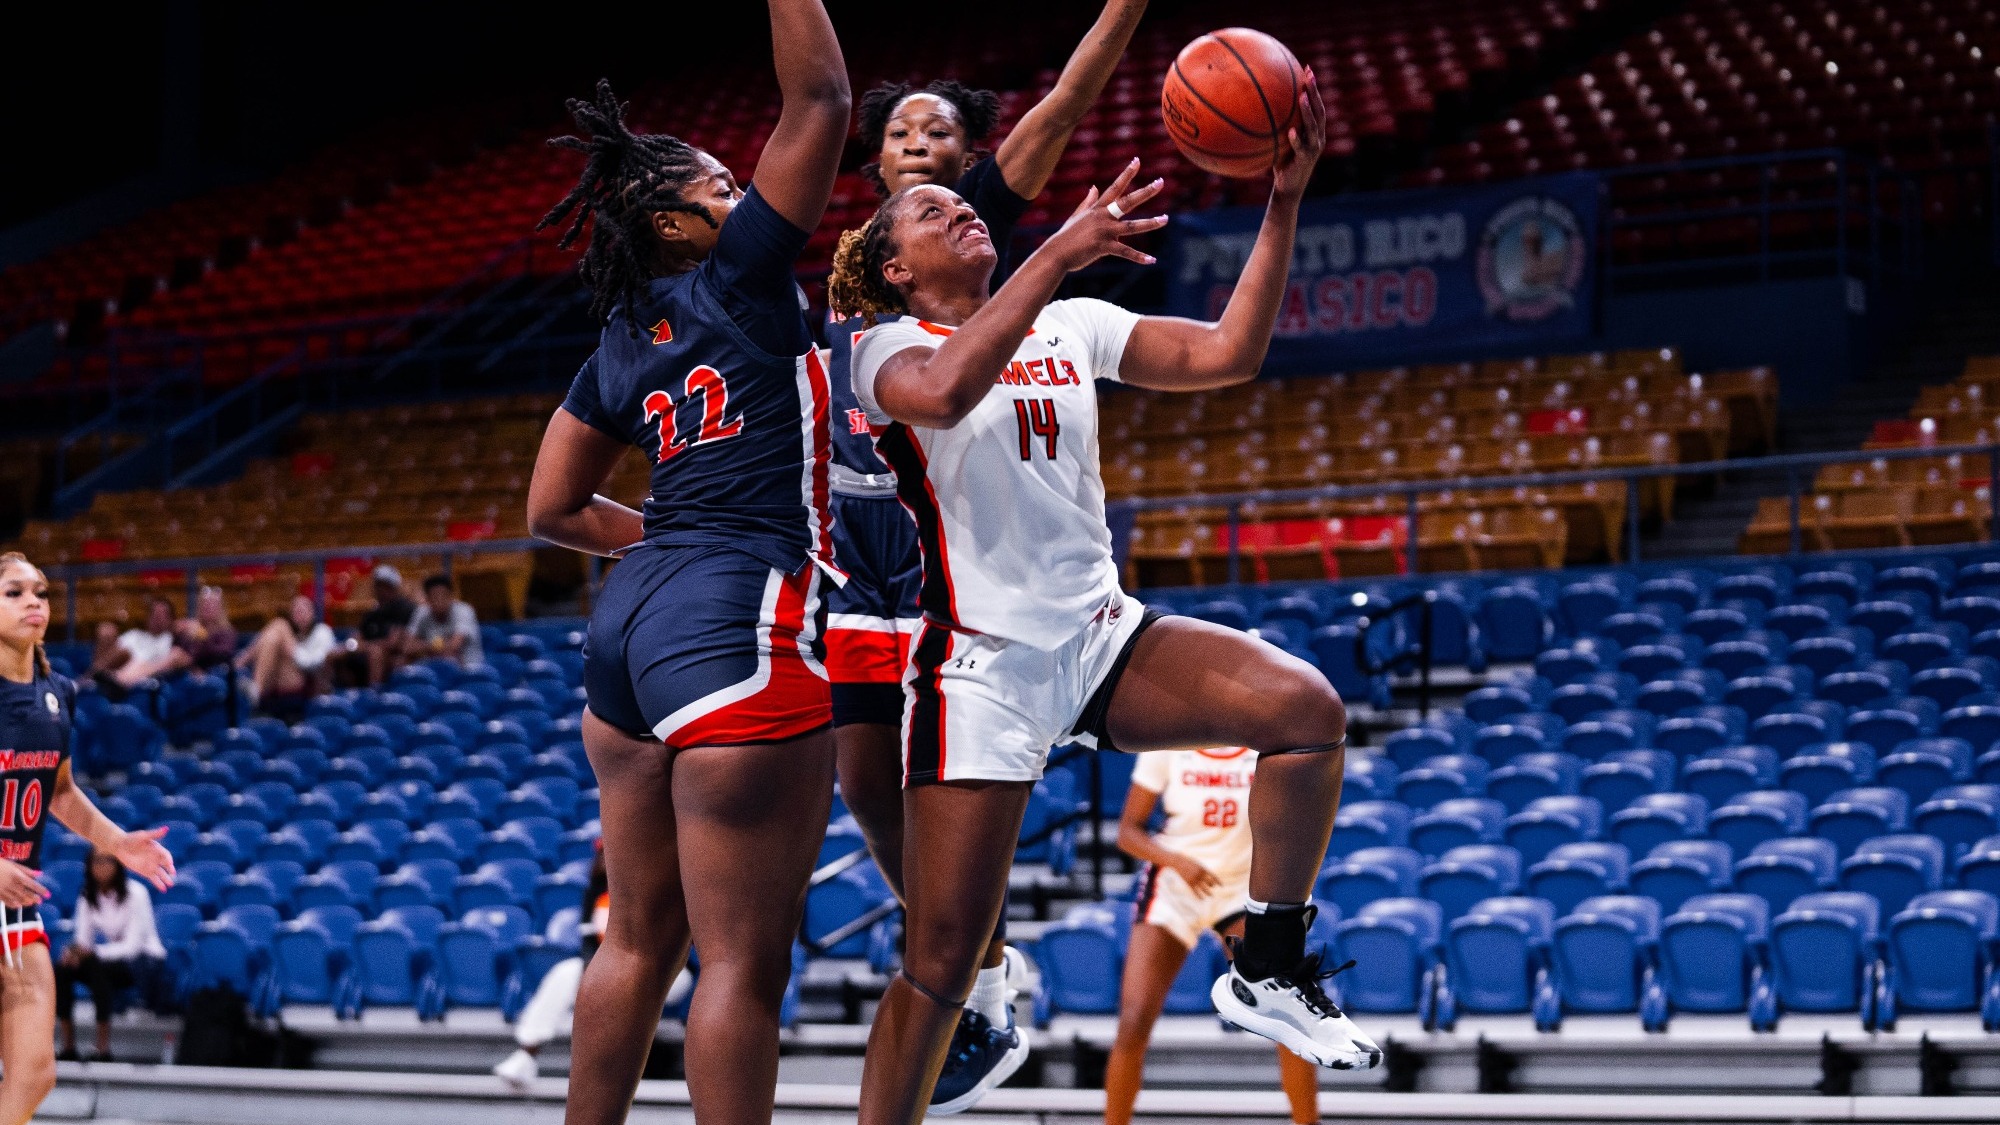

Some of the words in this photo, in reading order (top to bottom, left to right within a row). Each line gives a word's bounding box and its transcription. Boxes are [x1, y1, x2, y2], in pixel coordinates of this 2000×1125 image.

[1363, 211, 1467, 267] RICO
[1206, 265, 1438, 338] CASICO
[642, 364, 744, 464] 22
[1012, 398, 1060, 461] 14
[0, 778, 42, 831] 10
[1202, 797, 1238, 828] 22
